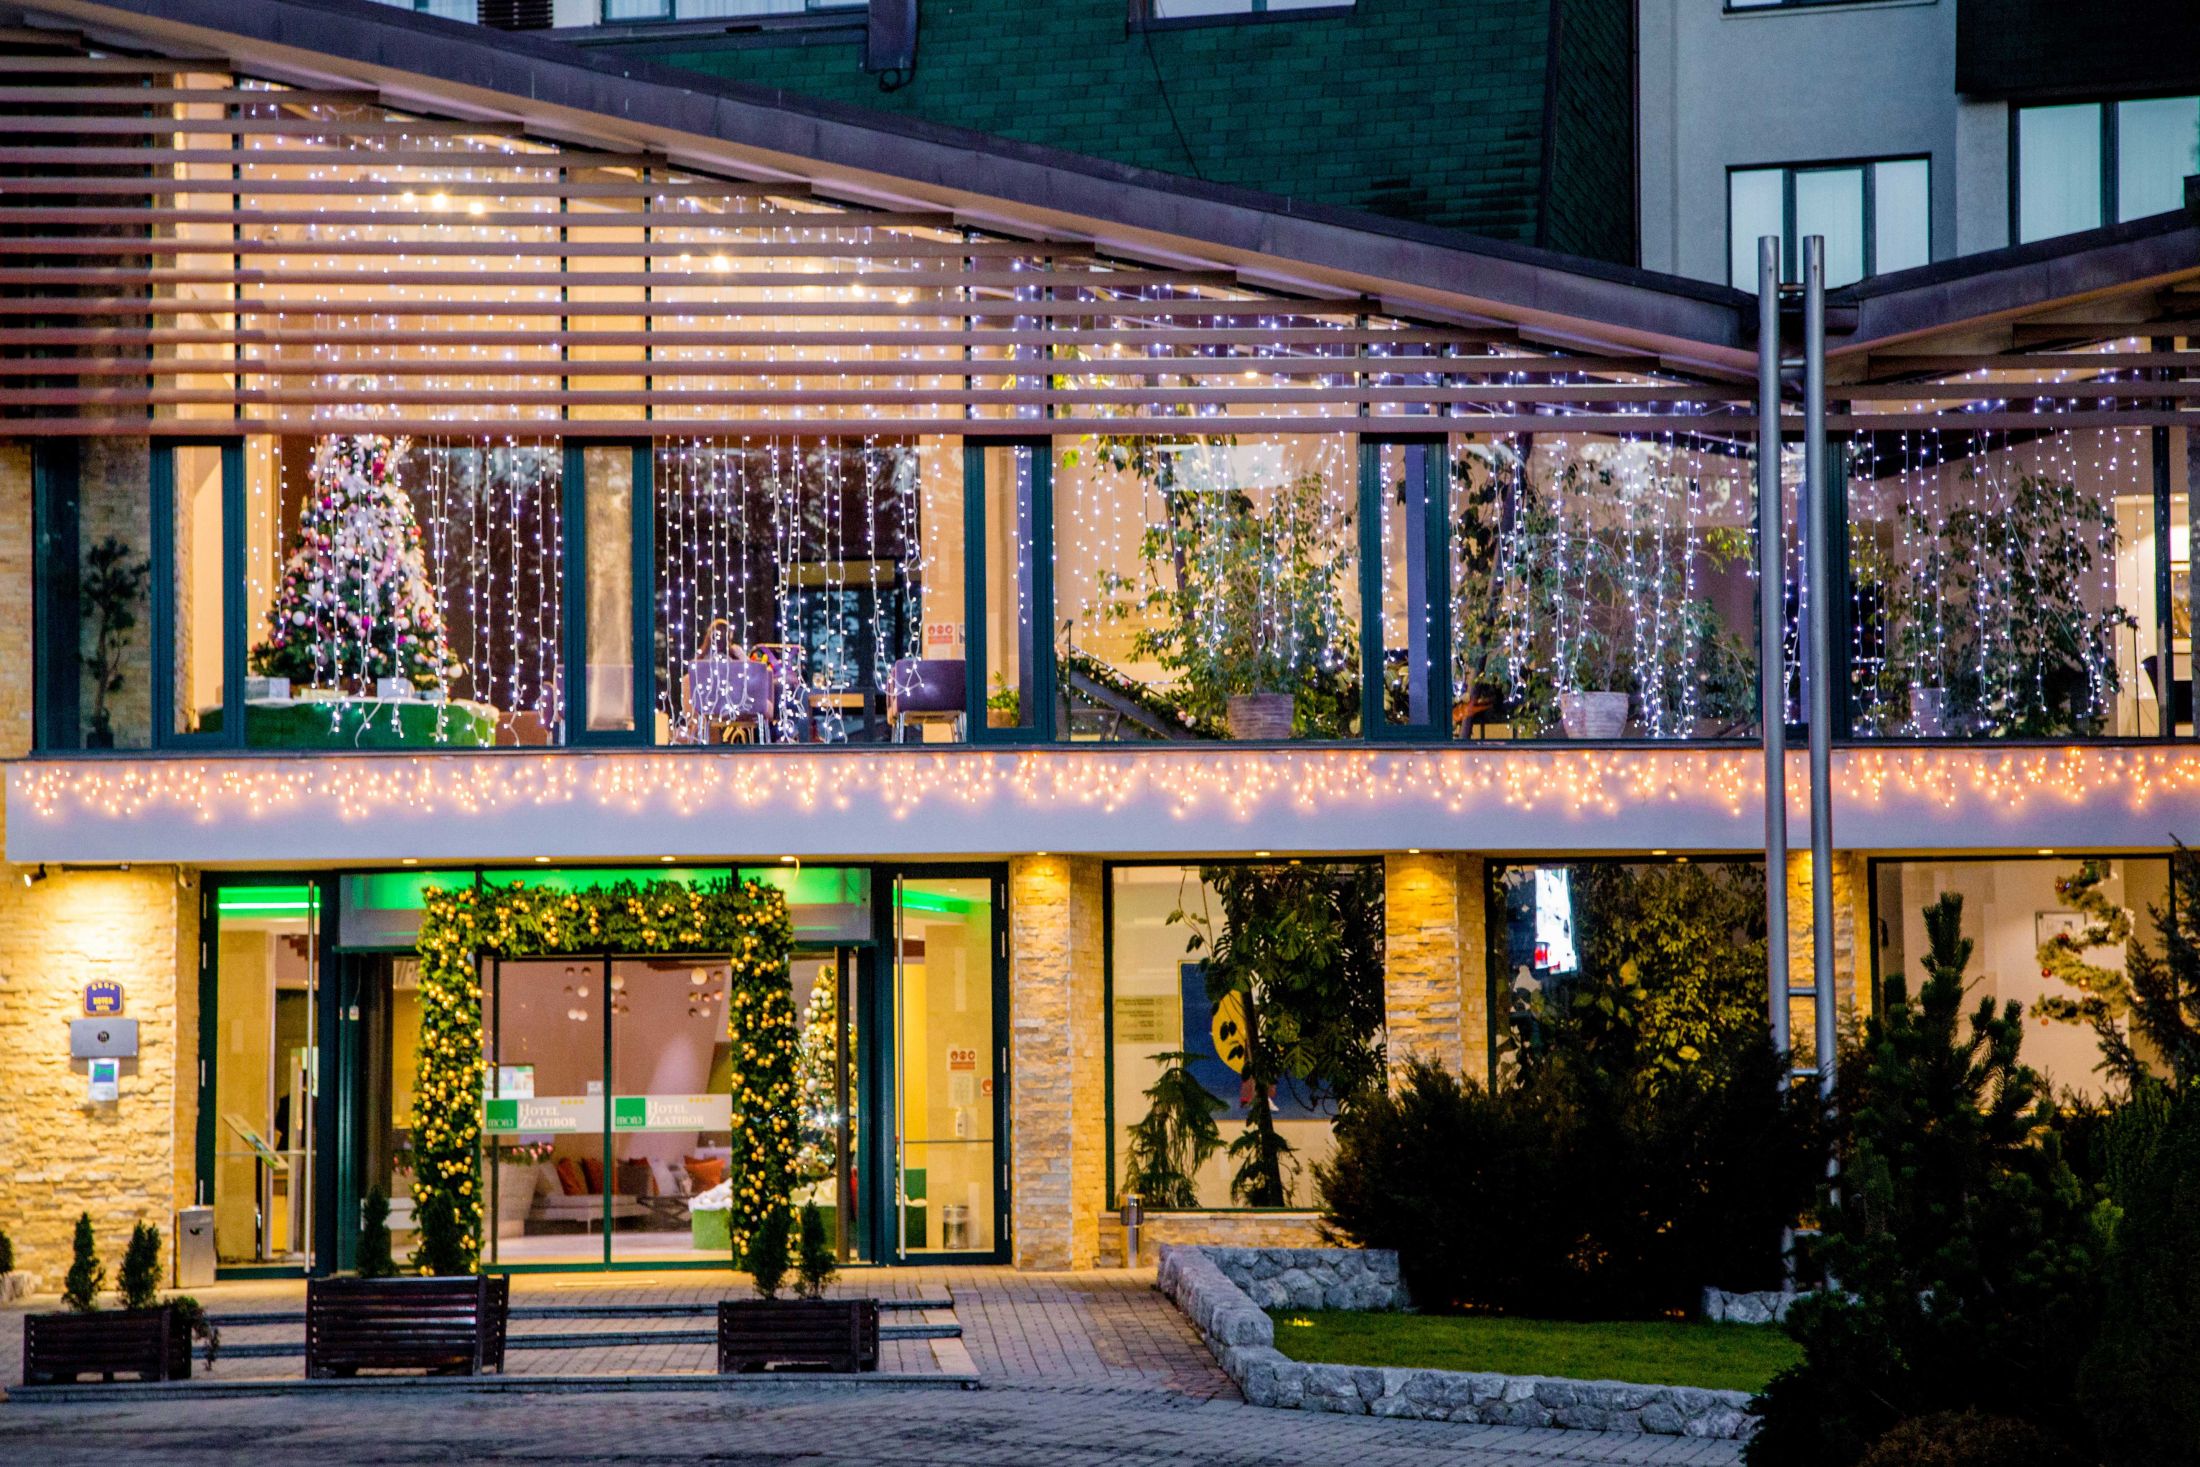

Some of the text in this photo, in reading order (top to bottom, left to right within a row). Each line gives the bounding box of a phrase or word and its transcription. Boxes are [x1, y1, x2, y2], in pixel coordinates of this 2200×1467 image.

[520, 1103, 559, 1116] HOTEL
[648, 1101, 688, 1114] HOTEL
[520, 1115, 577, 1128] ZLATIBOR
[648, 1113, 704, 1126] ZLATIBOR
